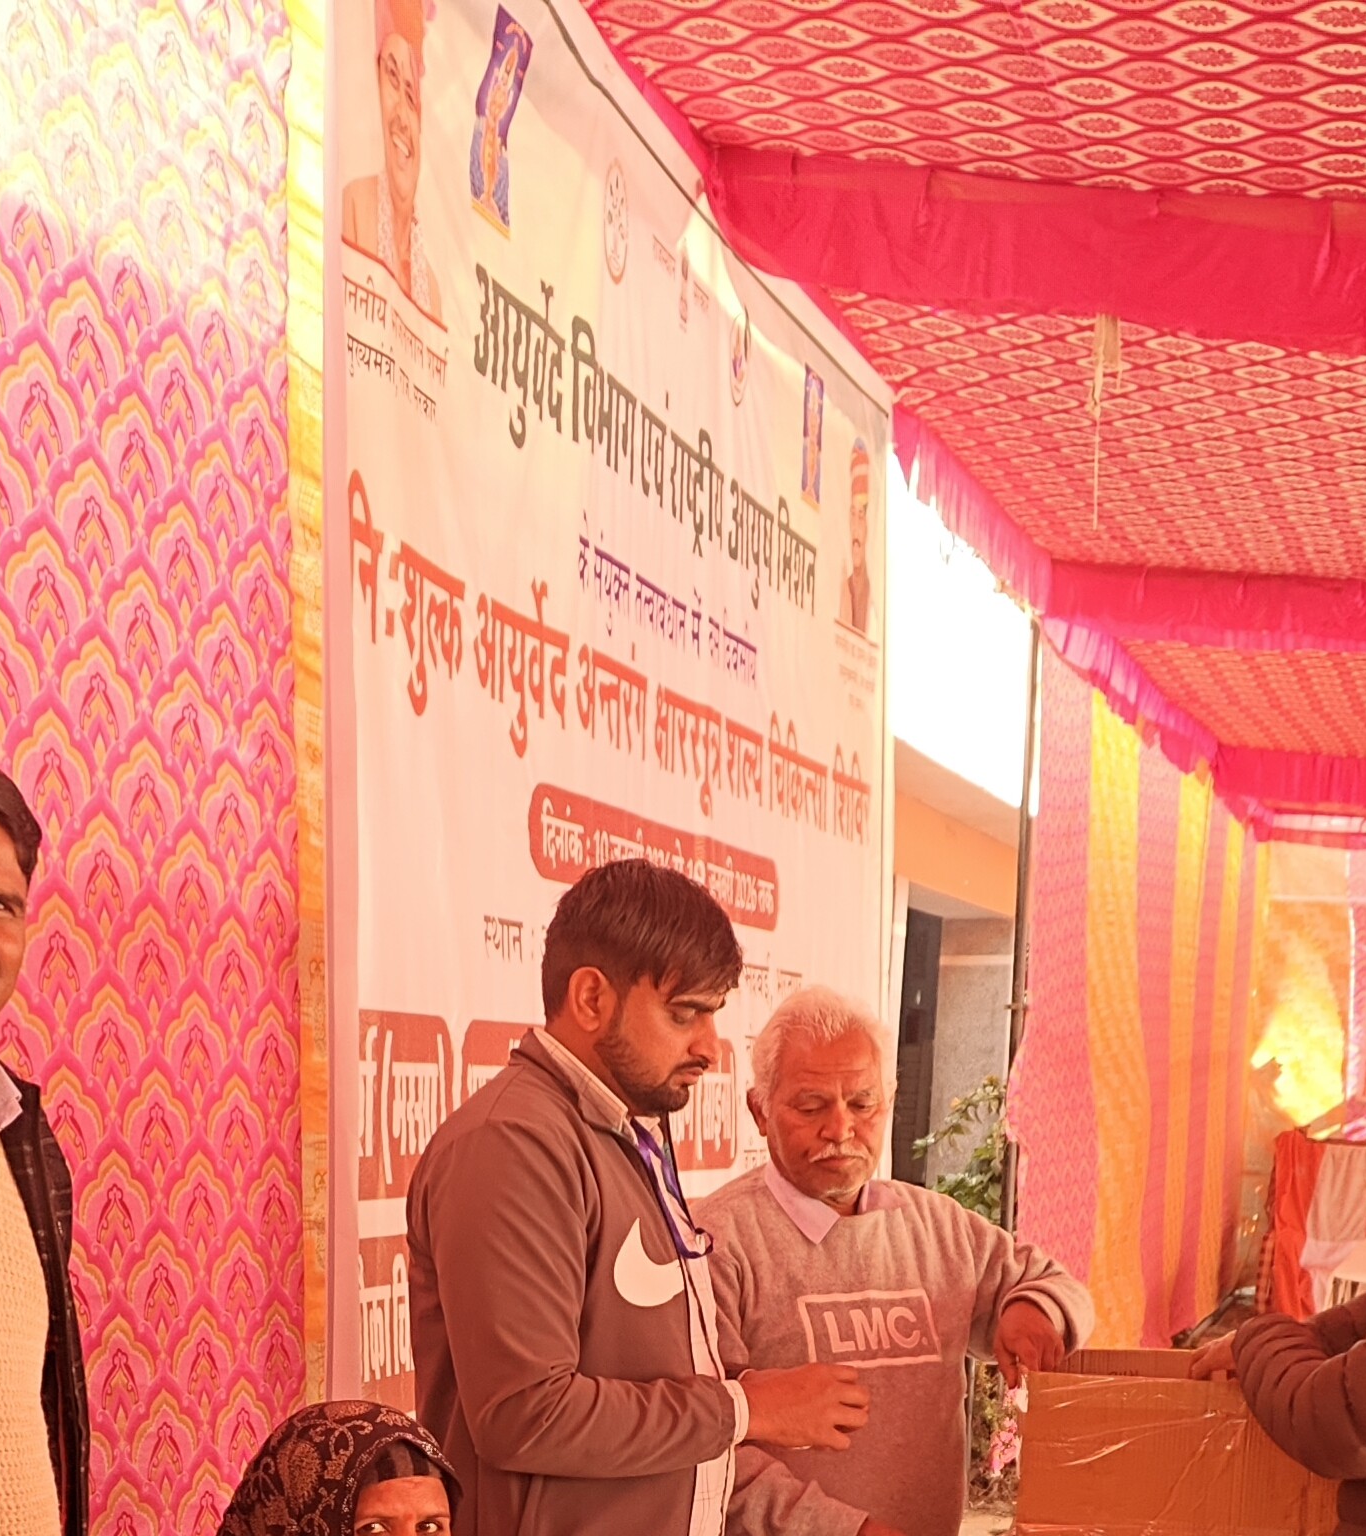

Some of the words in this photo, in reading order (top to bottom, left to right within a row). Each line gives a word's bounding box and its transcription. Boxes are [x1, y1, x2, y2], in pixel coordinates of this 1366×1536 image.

[342, 274, 387, 330] ाननीय
[474, 262, 566, 449] आयुर्वेद
[571, 315, 637, 485] विभाग
[641, 389, 667, 509] एवं
[670, 428, 724, 558] राष्ट्रीय
[728, 478, 774, 610] आयुष
[777, 495, 816, 616] मिशन
[473, 576, 570, 758] आयुर्वेद
[576, 642, 648, 761] अन्तरंग
[725, 717, 763, 807] शल्य
[768, 710, 828, 832] चिकित्सा
[484, 915, 523, 963] स्थान
